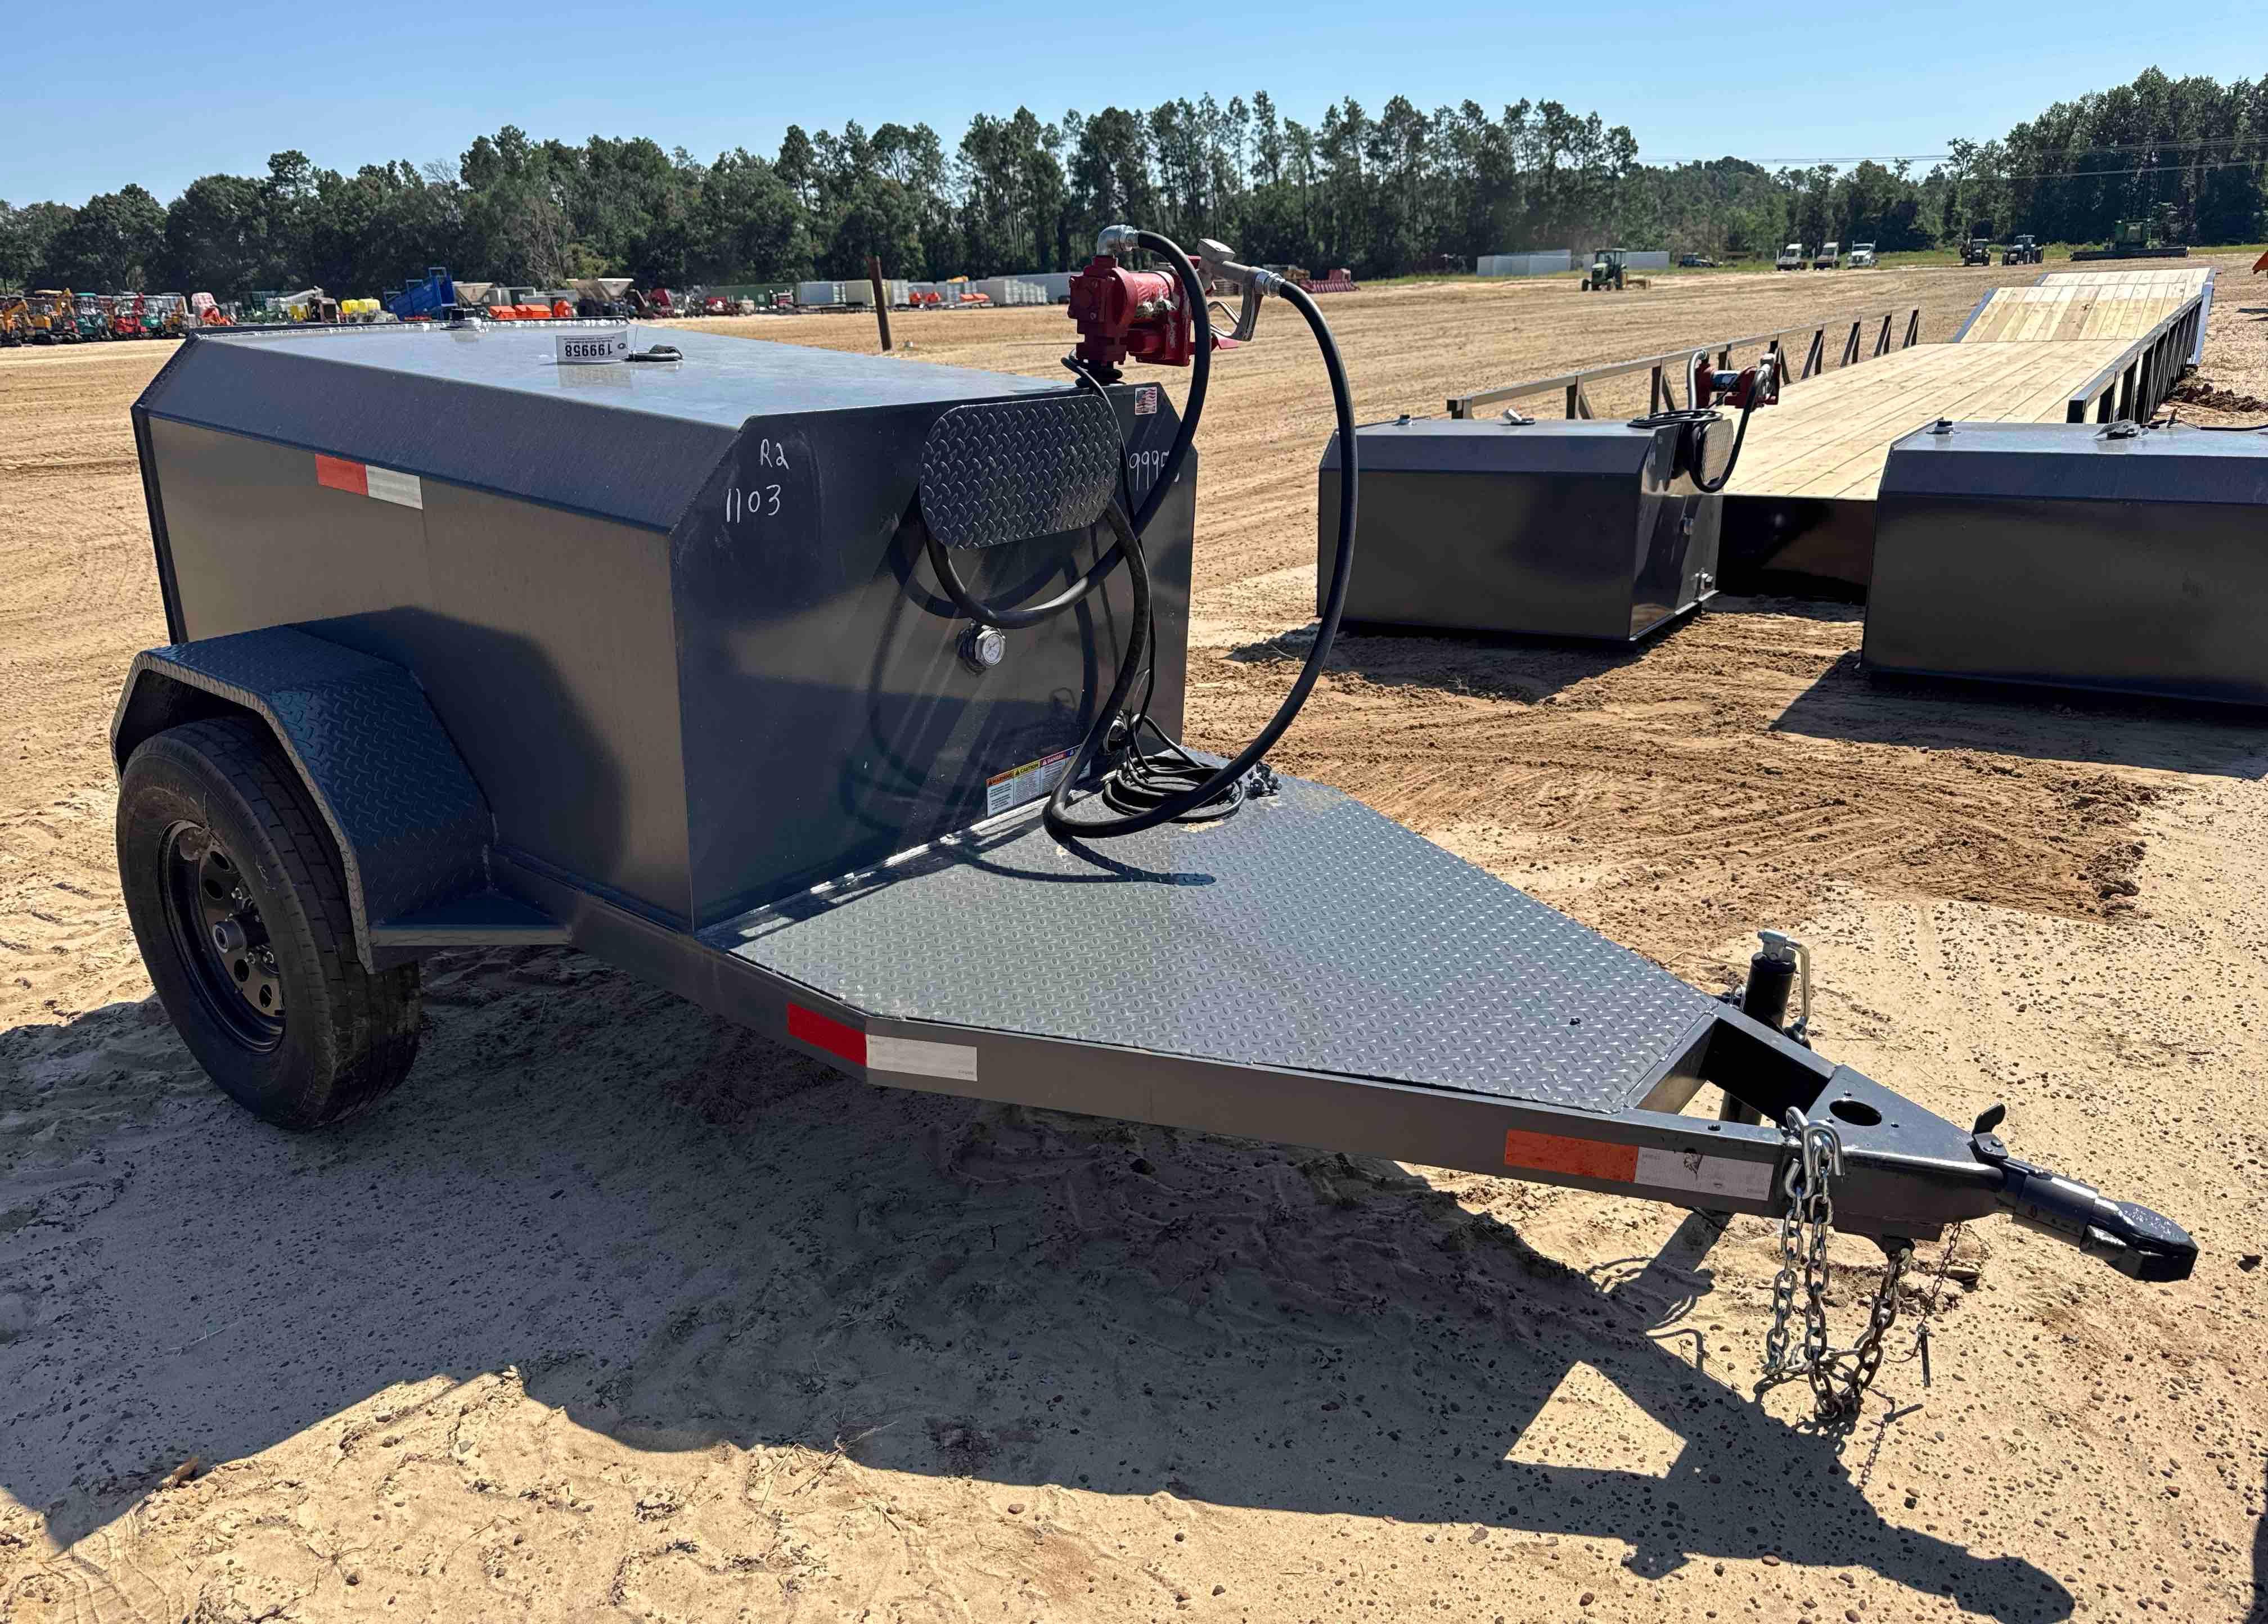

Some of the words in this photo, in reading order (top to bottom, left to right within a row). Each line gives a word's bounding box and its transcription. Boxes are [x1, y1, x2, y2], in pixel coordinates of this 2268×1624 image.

[565, 343, 613, 357] 199958
[760, 439, 789, 469] R2
[726, 484, 781, 523] 1103
[1020, 763, 1039, 773] CAUTION
